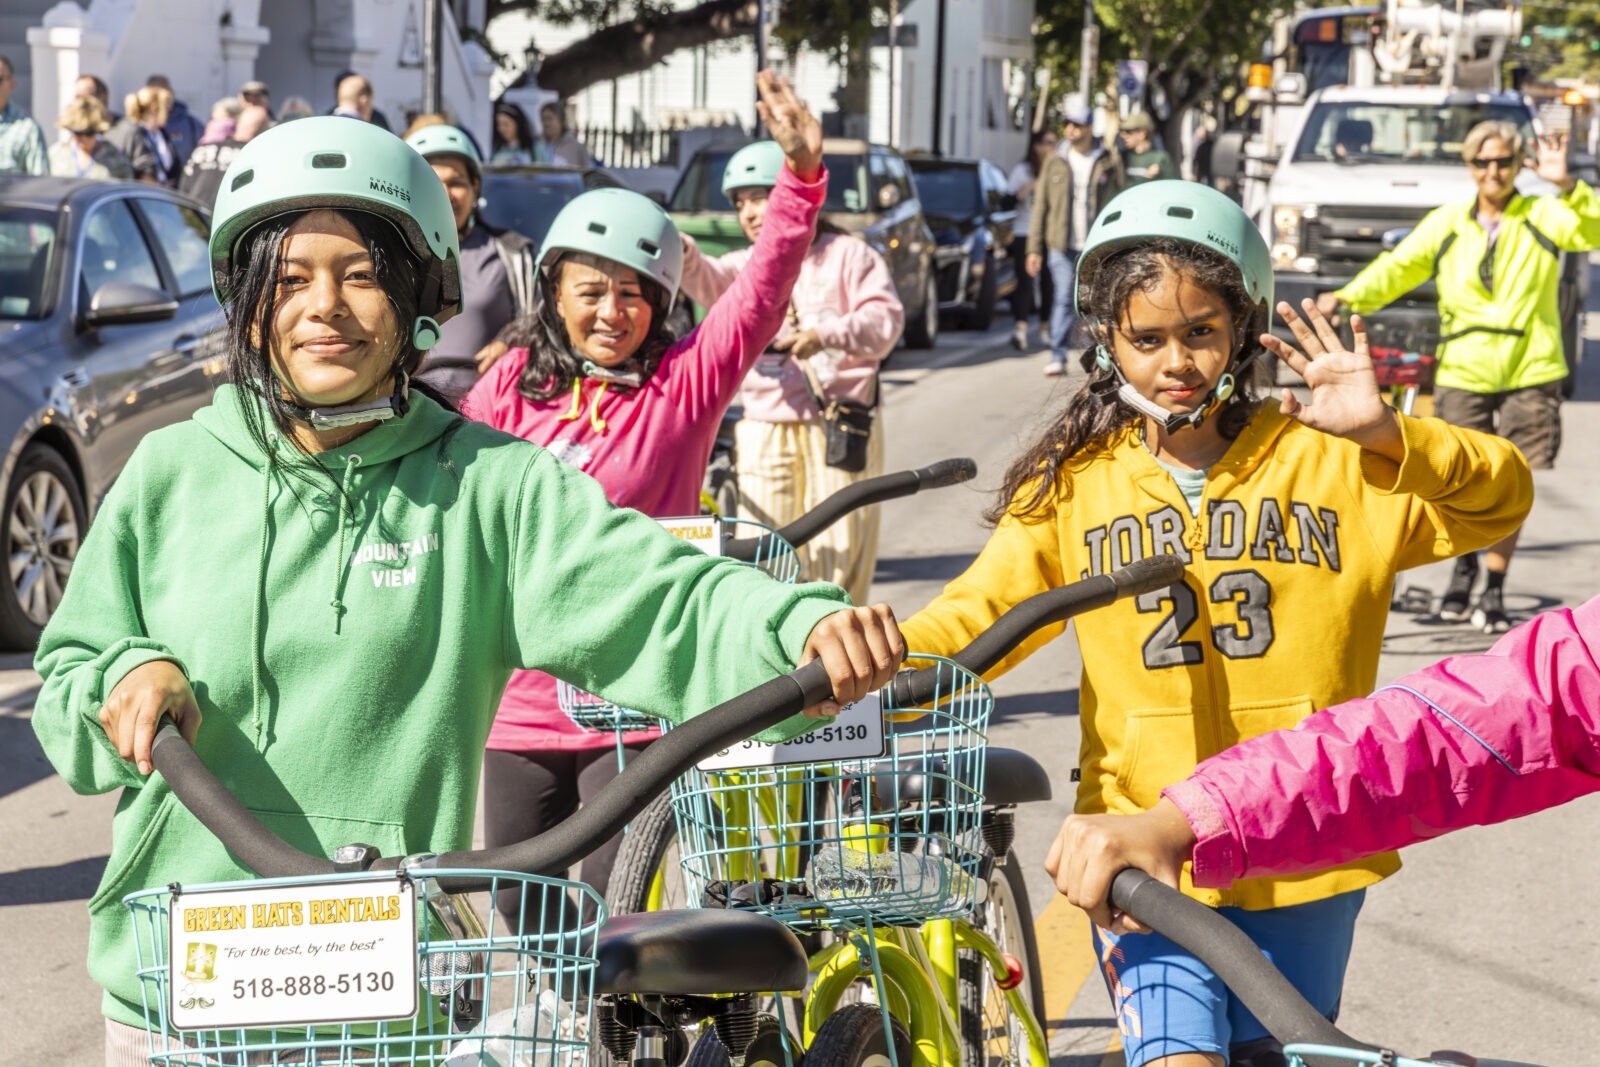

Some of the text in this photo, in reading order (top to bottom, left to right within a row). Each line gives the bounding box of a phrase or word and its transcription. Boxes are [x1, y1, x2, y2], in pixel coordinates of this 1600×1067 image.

[370, 181, 411, 203] MASTER
[666, 525, 713, 540] NTALS
[1081, 498, 1341, 578] JORDAN
[350, 532, 439, 567] MOUNTAIN
[372, 566, 417, 588] VIEW
[1135, 569, 1276, 669] 23
[184, 896, 401, 933] GREEN HATS RENTALS
[250, 945, 271, 957] the
[274, 943, 303, 956] best,
[307, 942, 323, 957] by
[325, 941, 346, 953] the
[233, 971, 395, 1000] 518-888-5130
